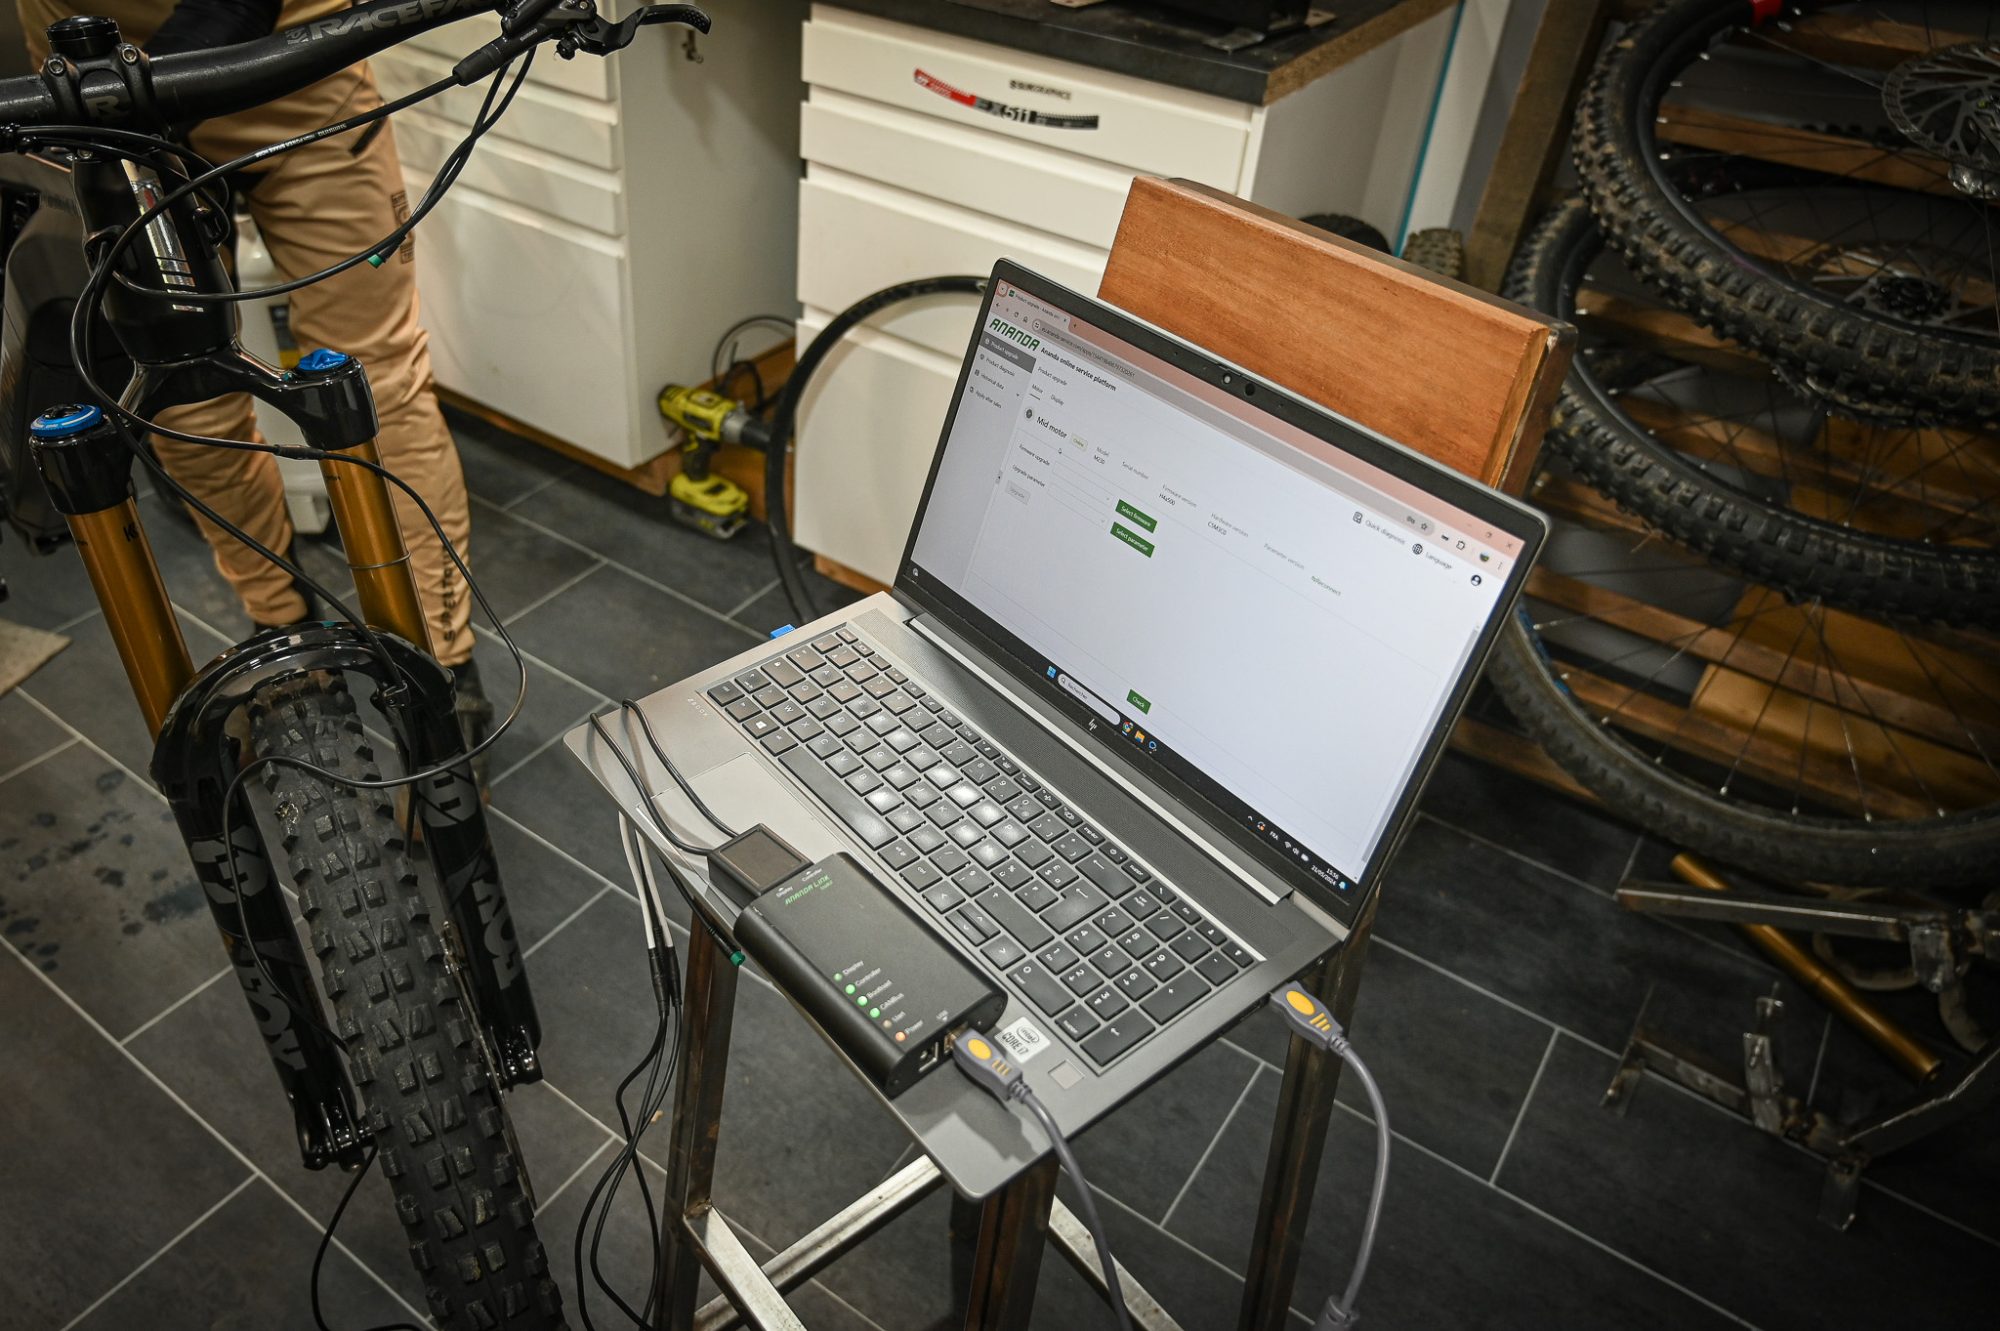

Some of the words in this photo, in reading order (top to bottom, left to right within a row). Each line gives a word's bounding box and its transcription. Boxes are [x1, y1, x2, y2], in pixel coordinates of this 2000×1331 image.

[989, 318, 1040, 352] ANANDA
[1037, 367, 1052, 377] Product
[1051, 374, 1067, 387] upgrade
[1040, 347, 1059, 360] Ananda
[1059, 357, 1075, 369] online
[1075, 365, 1093, 378] service
[1092, 375, 1116, 392] platform
[1036, 416, 1049, 427] Mid
[1048, 424, 1067, 438] motor
[1120, 505, 1133, 516] Select
[785, 884, 813, 905] ANANDA
[1002, 1031, 1023, 1050] CORE
